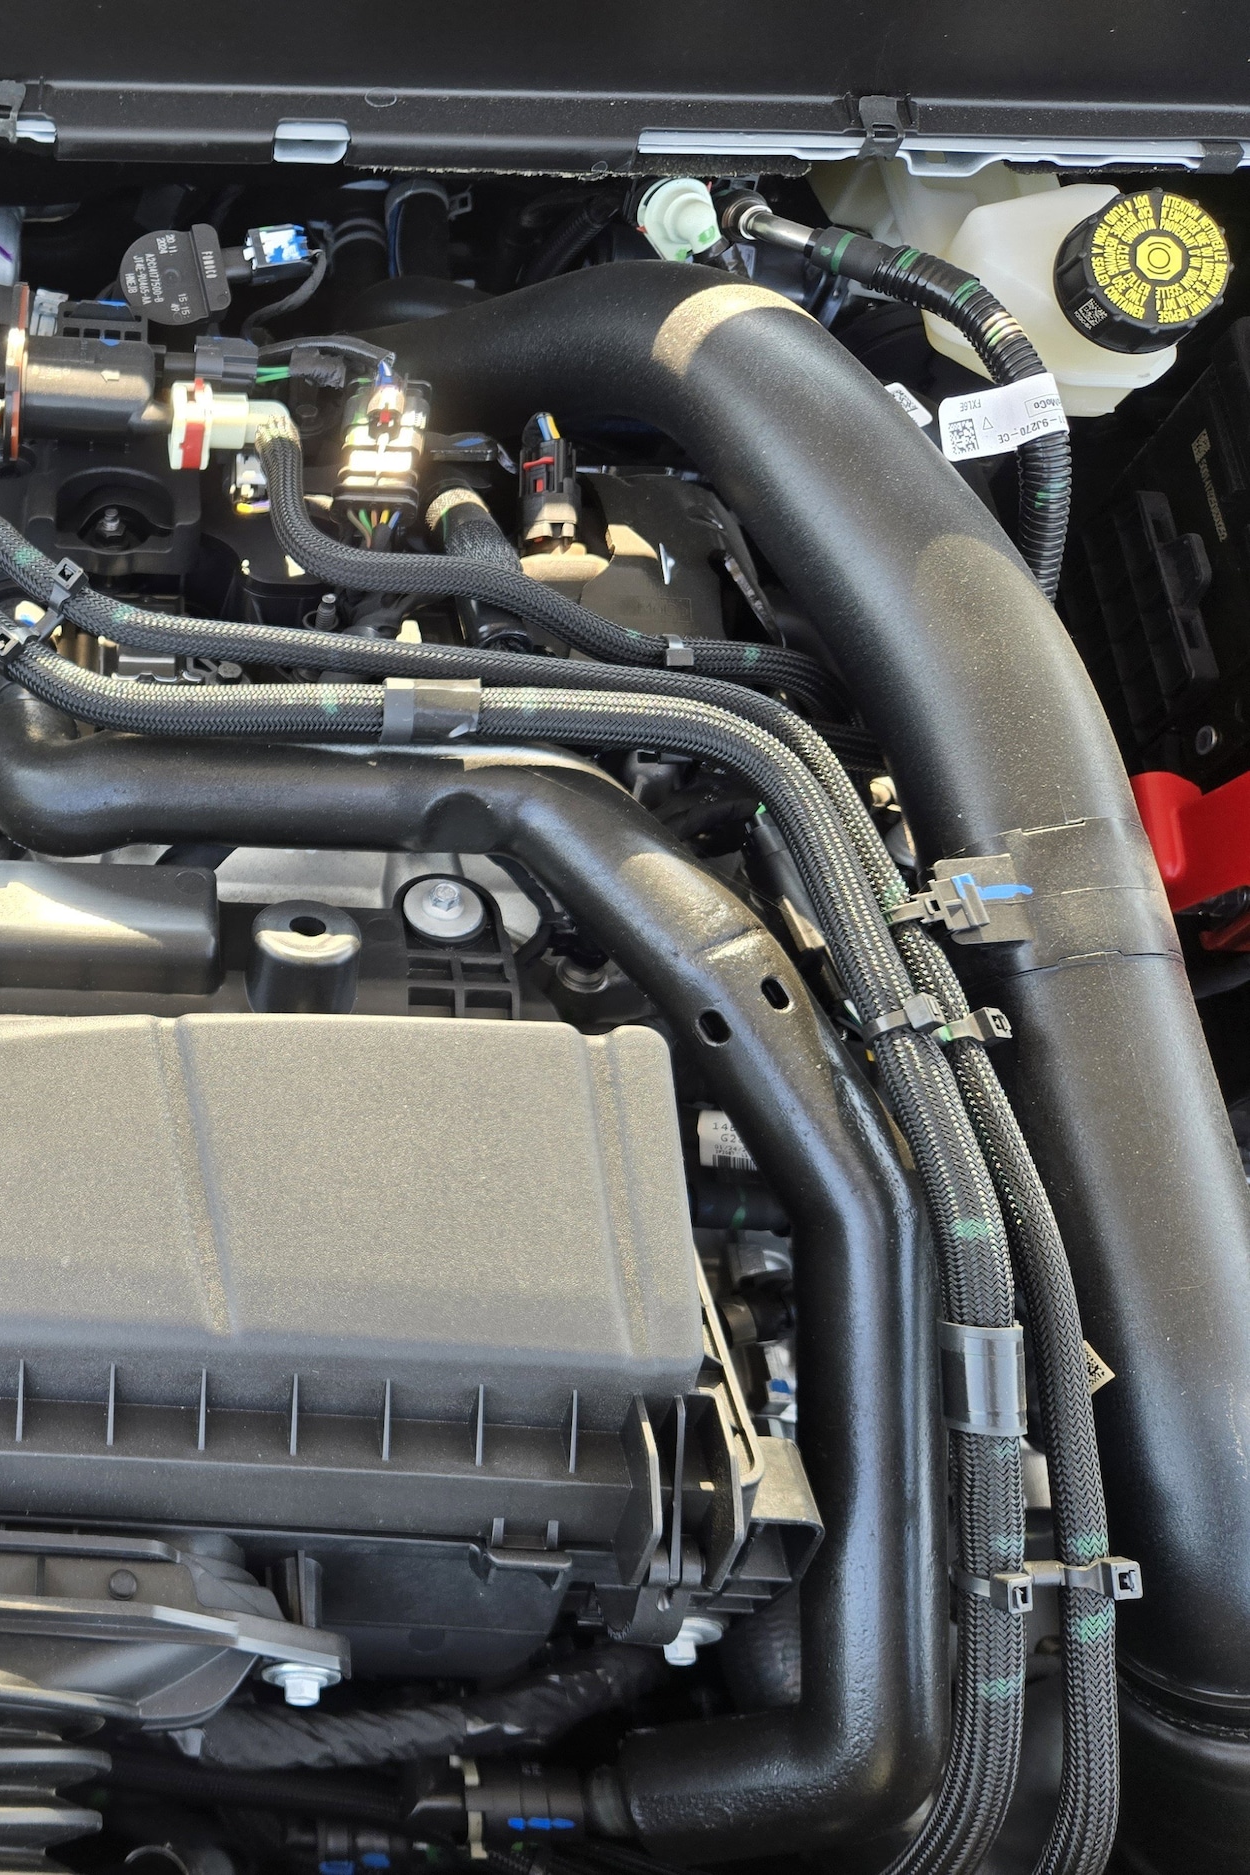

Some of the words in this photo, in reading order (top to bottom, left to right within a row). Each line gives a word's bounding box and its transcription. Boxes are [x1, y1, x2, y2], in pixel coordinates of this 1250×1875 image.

[1123, 199, 1133, 211] 4
[1131, 194, 1149, 209] DOT
[1162, 195, 1203, 219] ATTENTION
[1102, 203, 1126, 225] FLUID
[1109, 211, 1137, 237] BEFORE
[1135, 206, 1152, 220] CAP
[1091, 222, 1111, 245] FROM
[1120, 217, 1155, 244] WARNING
[1160, 218, 1199, 248] PROVENANT
[1194, 230, 1210, 246] QUE
[1197, 213, 1224, 250] NETTOYER
[156, 237, 167, 254] 2024
[1090, 246, 1104, 254] A
[1103, 235, 1119, 276] REMOVING
[1200, 245, 1213, 255] DU
[1214, 250, 1226, 260] LE
[1116, 244, 1131, 272] CLEAN
[1091, 256, 1110, 287] SEALED
[1179, 268, 1199, 290] BIDON
[1197, 258, 1214, 284] LIQUIDE
[1205, 263, 1227, 297] BOUCHON
[1111, 275, 1128, 293] USE
[1123, 271, 1151, 296] FILLER
[1192, 280, 1206, 294] DE
[1102, 284, 1144, 320] CONTAINER
[1123, 287, 1146, 306] ONLY
[1154, 298, 1161, 310] 4
[1163, 297, 1177, 310] DOT
[1176, 288, 1198, 307] FREIN
[1187, 292, 1213, 316] AVANT
[1158, 306, 1189, 323] DEPOSE
